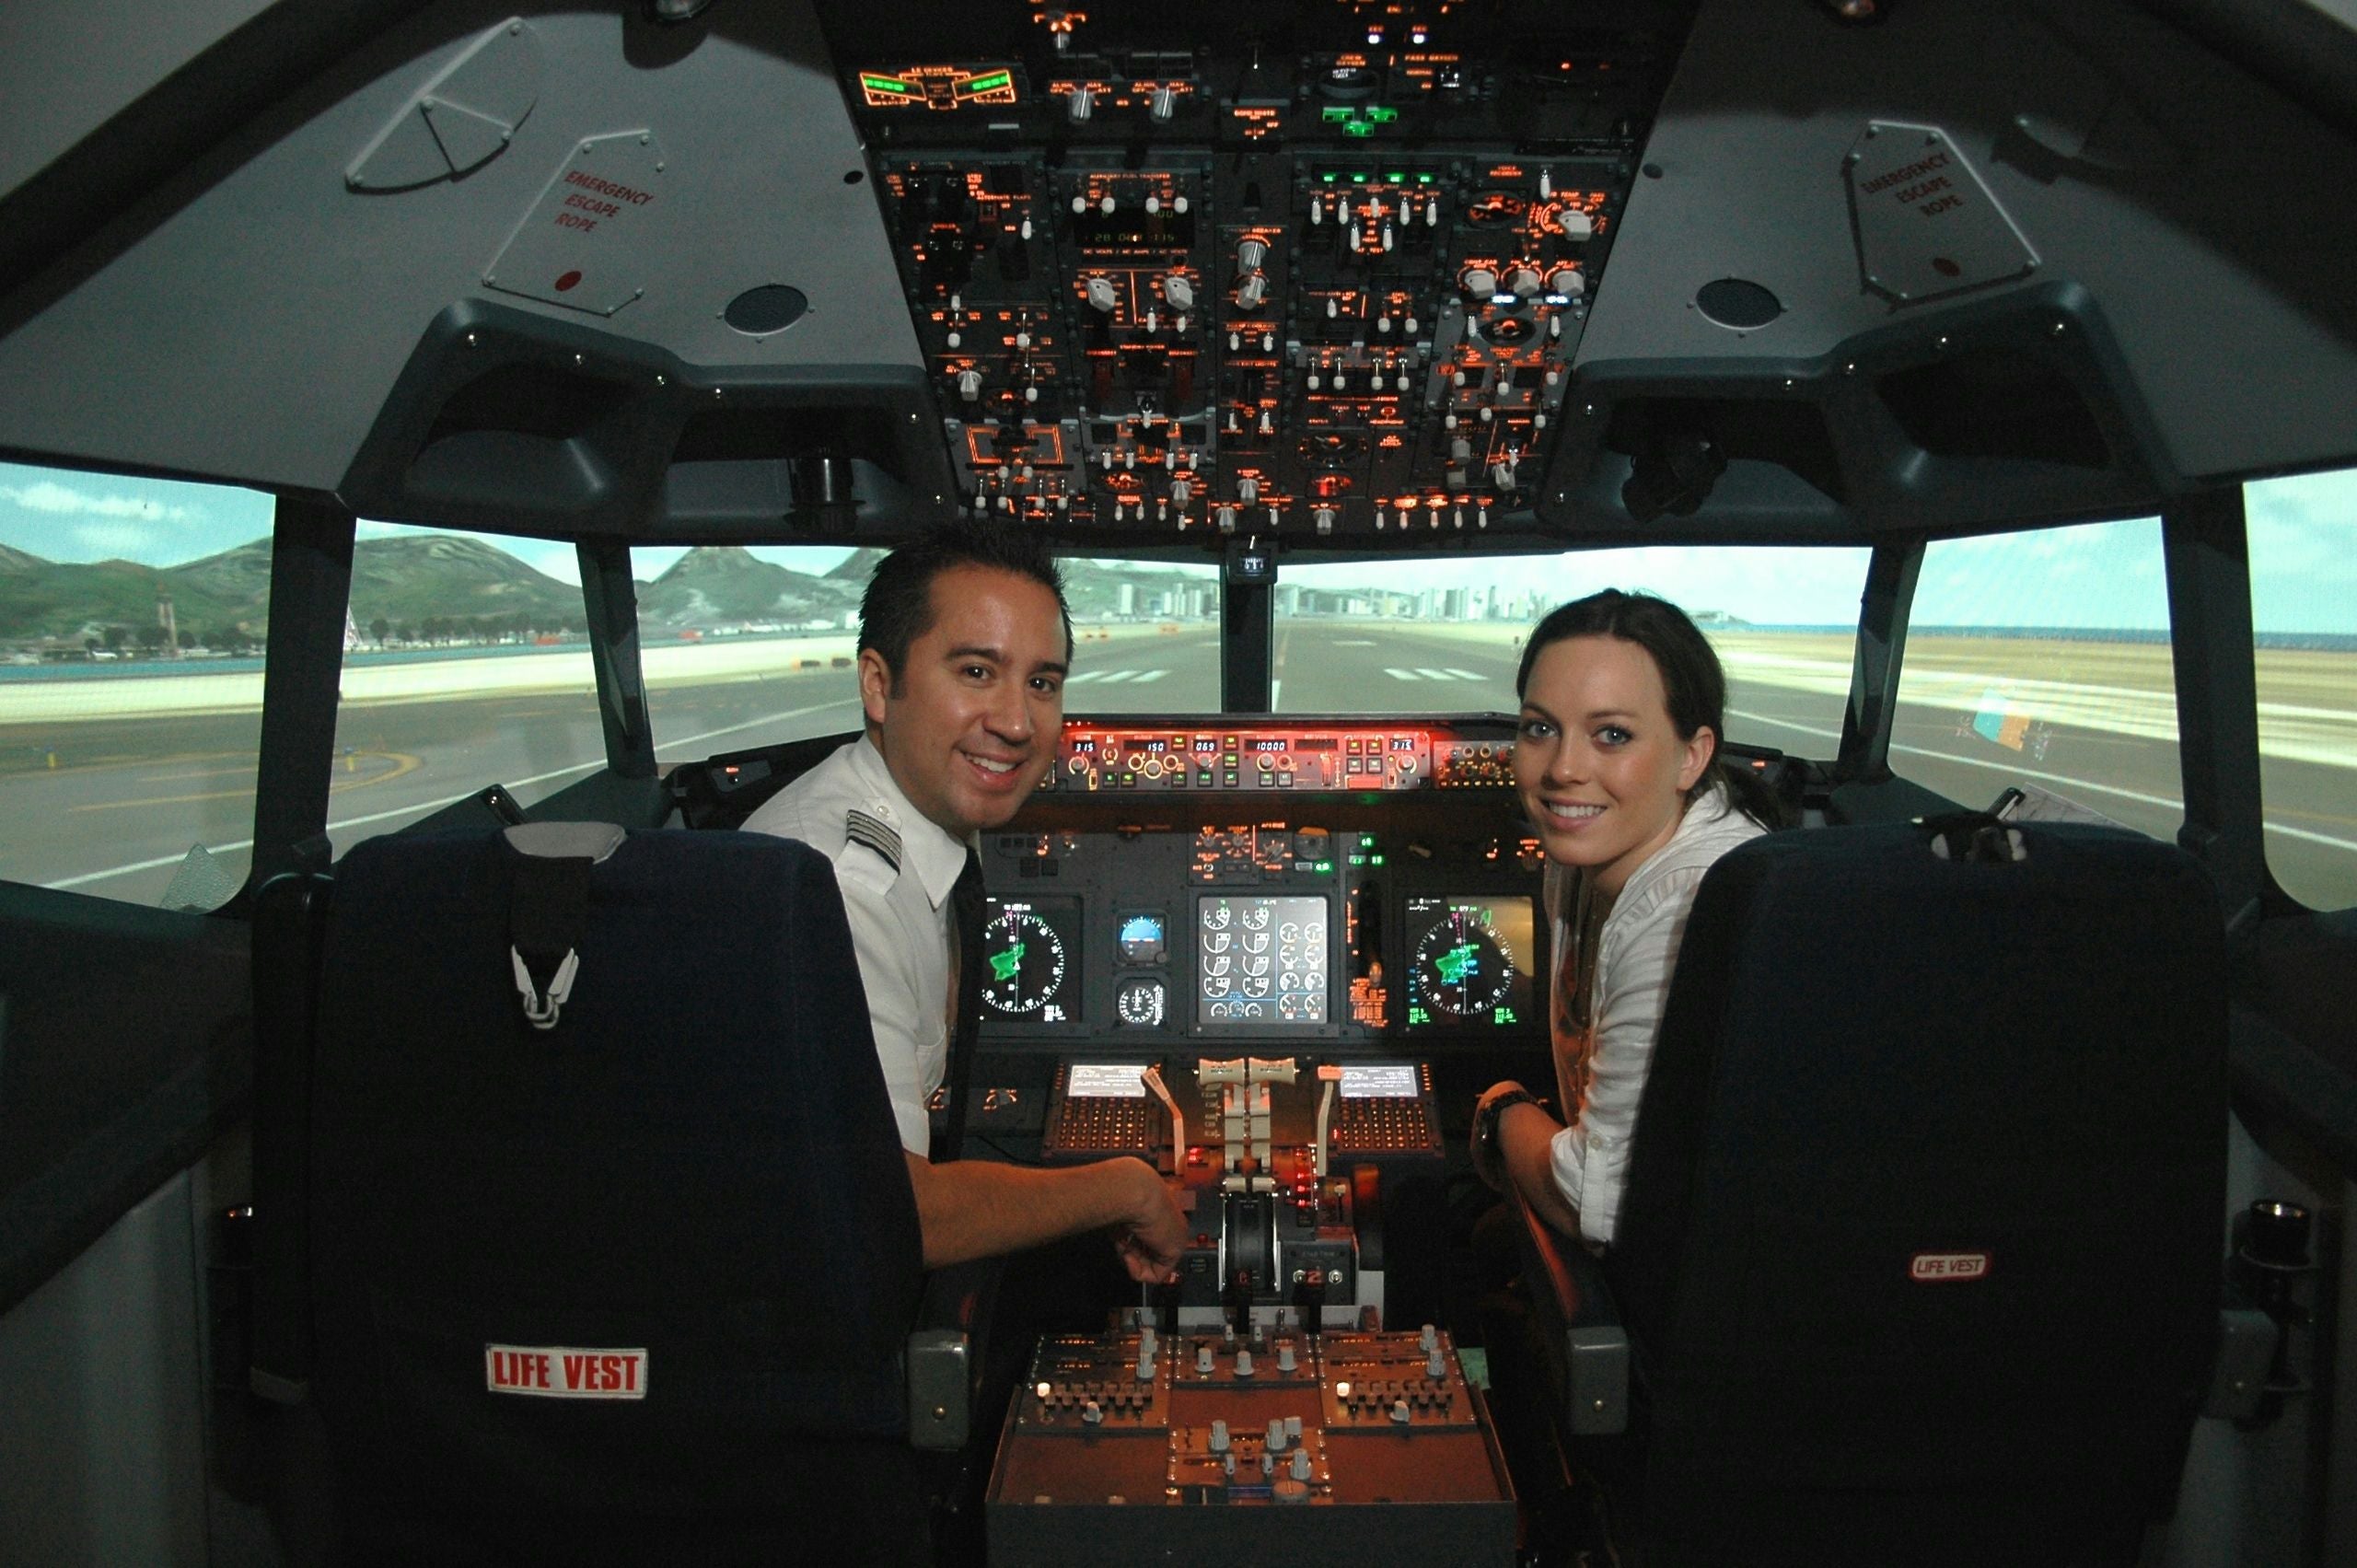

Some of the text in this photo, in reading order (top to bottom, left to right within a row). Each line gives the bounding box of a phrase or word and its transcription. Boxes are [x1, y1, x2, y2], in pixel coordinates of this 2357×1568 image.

[1860, 152, 1950, 194] EMERGENCY
[564, 170, 655, 205] EMERGENCY
[1896, 176, 1952, 203] ESCAPE
[563, 193, 621, 217] ESCAPE
[1920, 194, 1963, 216] ROPE
[554, 213, 598, 233] ROPE
[1917, 1259, 1982, 1273] LIFE VEST
[493, 1352, 639, 1390] LIFE VEST
